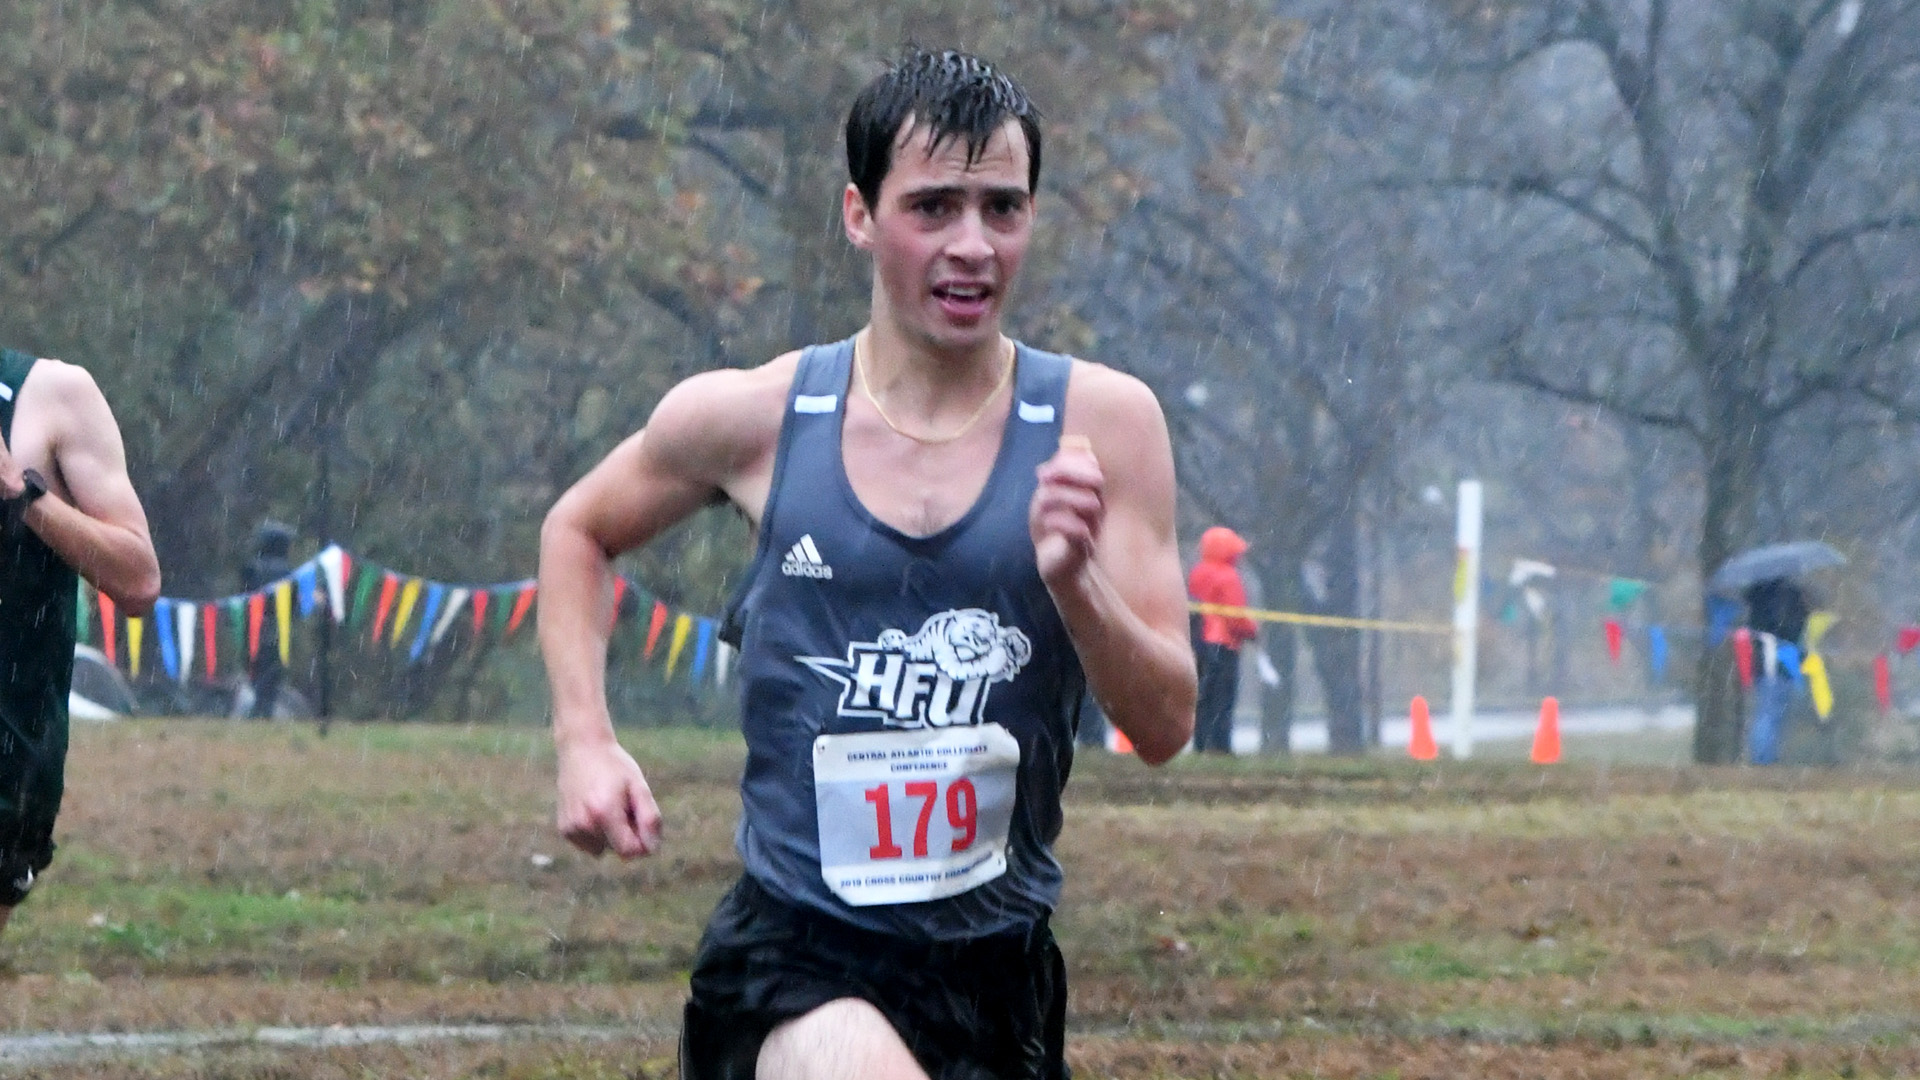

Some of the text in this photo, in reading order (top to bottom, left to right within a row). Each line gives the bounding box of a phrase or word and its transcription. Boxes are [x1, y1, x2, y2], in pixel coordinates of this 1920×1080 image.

[782, 561, 833, 580] adidas
[851, 652, 982, 727] HFU
[847, 751, 887, 762] CENTRAL
[891, 748, 933, 759] ATLANTIC
[890, 762, 948, 773] CONFERENCE
[865, 776, 977, 860] 179
[865, 876, 896, 886] CROSS
[899, 873, 941, 883] COUNTRY
